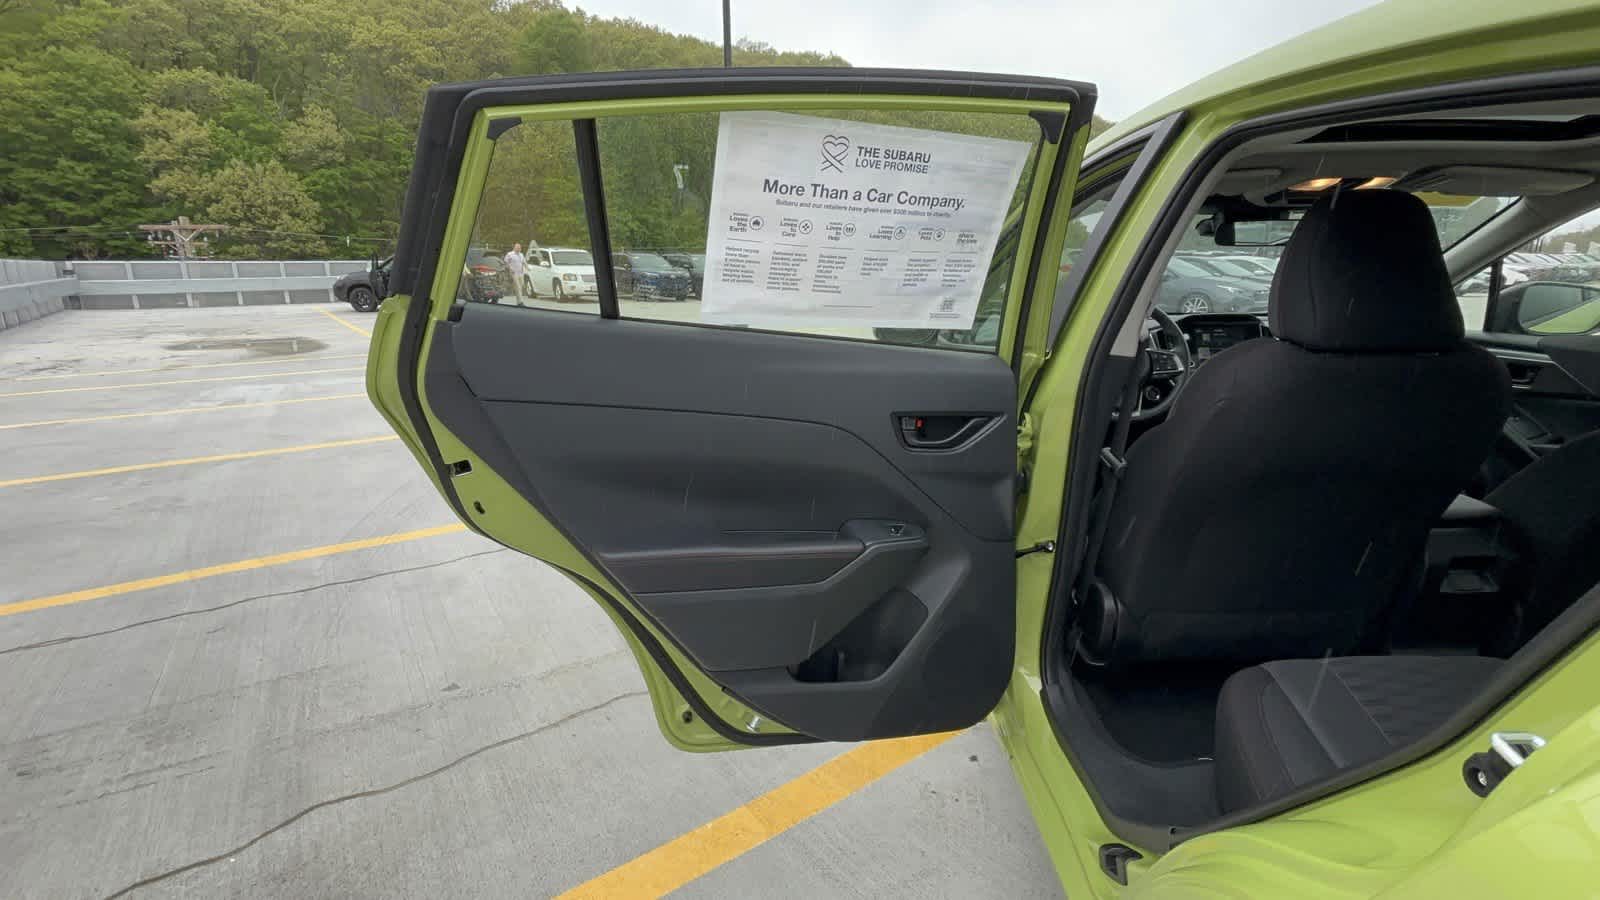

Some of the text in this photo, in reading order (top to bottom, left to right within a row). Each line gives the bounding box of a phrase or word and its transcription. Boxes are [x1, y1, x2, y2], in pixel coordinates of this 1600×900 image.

[857, 146, 931, 164] THE SUBARU
[855, 158, 929, 174] LOVE PROMISE
[762, 178, 966, 210] More Than a Car Company.
